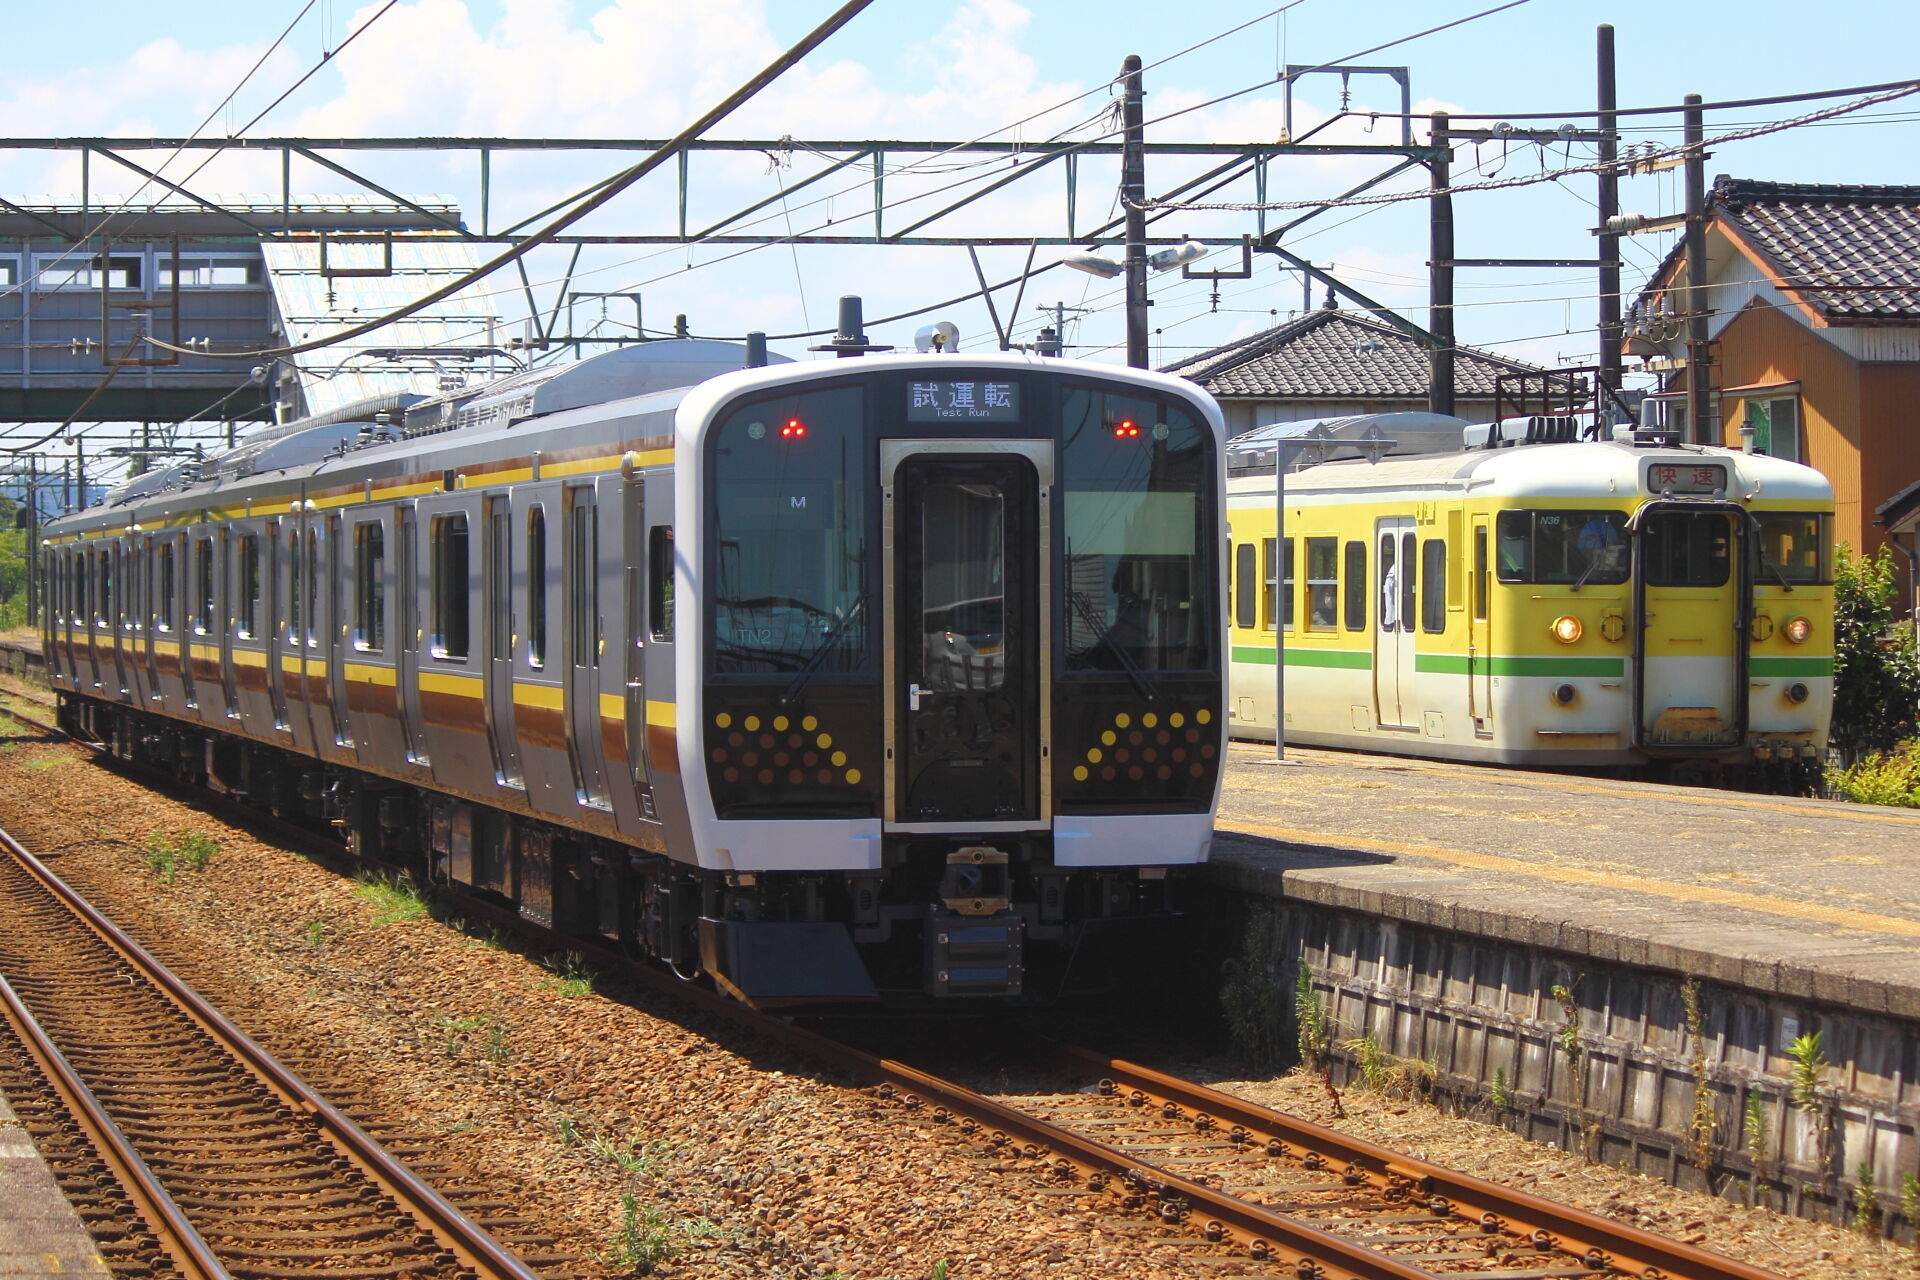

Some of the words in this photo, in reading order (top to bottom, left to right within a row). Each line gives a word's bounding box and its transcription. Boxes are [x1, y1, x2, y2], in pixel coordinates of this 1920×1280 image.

[912, 382, 1011, 408] 試運転
[936, 407, 963, 417] Test
[969, 407, 990, 417] Run
[1655, 466, 1714, 486] 快速
[790, 496, 806, 509] M
[1540, 516, 1560, 525] N36
[737, 628, 772, 644] TN2
